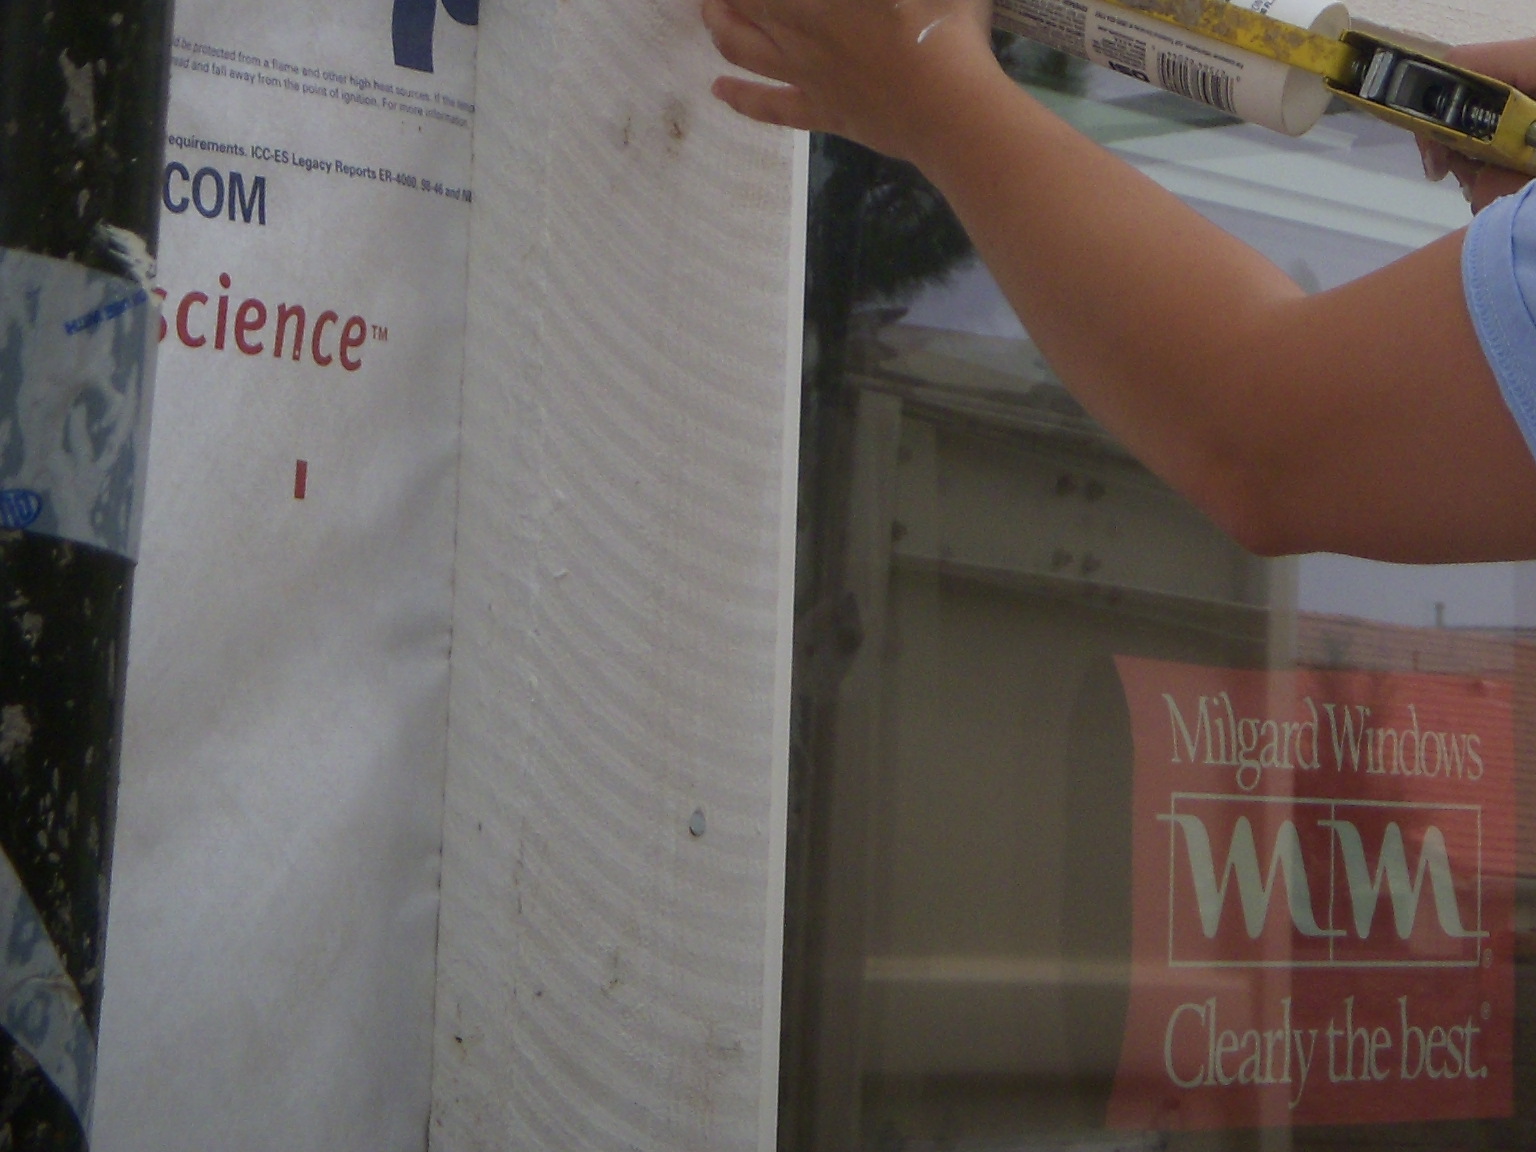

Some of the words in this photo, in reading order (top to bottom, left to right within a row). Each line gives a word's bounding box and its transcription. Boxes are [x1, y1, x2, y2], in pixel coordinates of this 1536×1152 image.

[191, 60, 209, 73] and
[229, 69, 256, 85] away
[258, 73, 282, 88] from
[284, 78, 300, 91] the
[302, 83, 327, 97] point
[329, 87, 339, 98] of
[238, 51, 261, 67] from
[263, 59, 270, 69] a
[302, 67, 320, 78] and
[251, 145, 289, 164] ICC-ES
[293, 152, 332, 174] Legacy
[335, 159, 377, 179] Reports
[163, 161, 267, 225] COM
[1161, 691, 1321, 791] Milgard
[1321, 702, 1485, 781] Windows
[1163, 996, 1318, 1110] Clearly
[1325, 995, 1393, 1084] the
